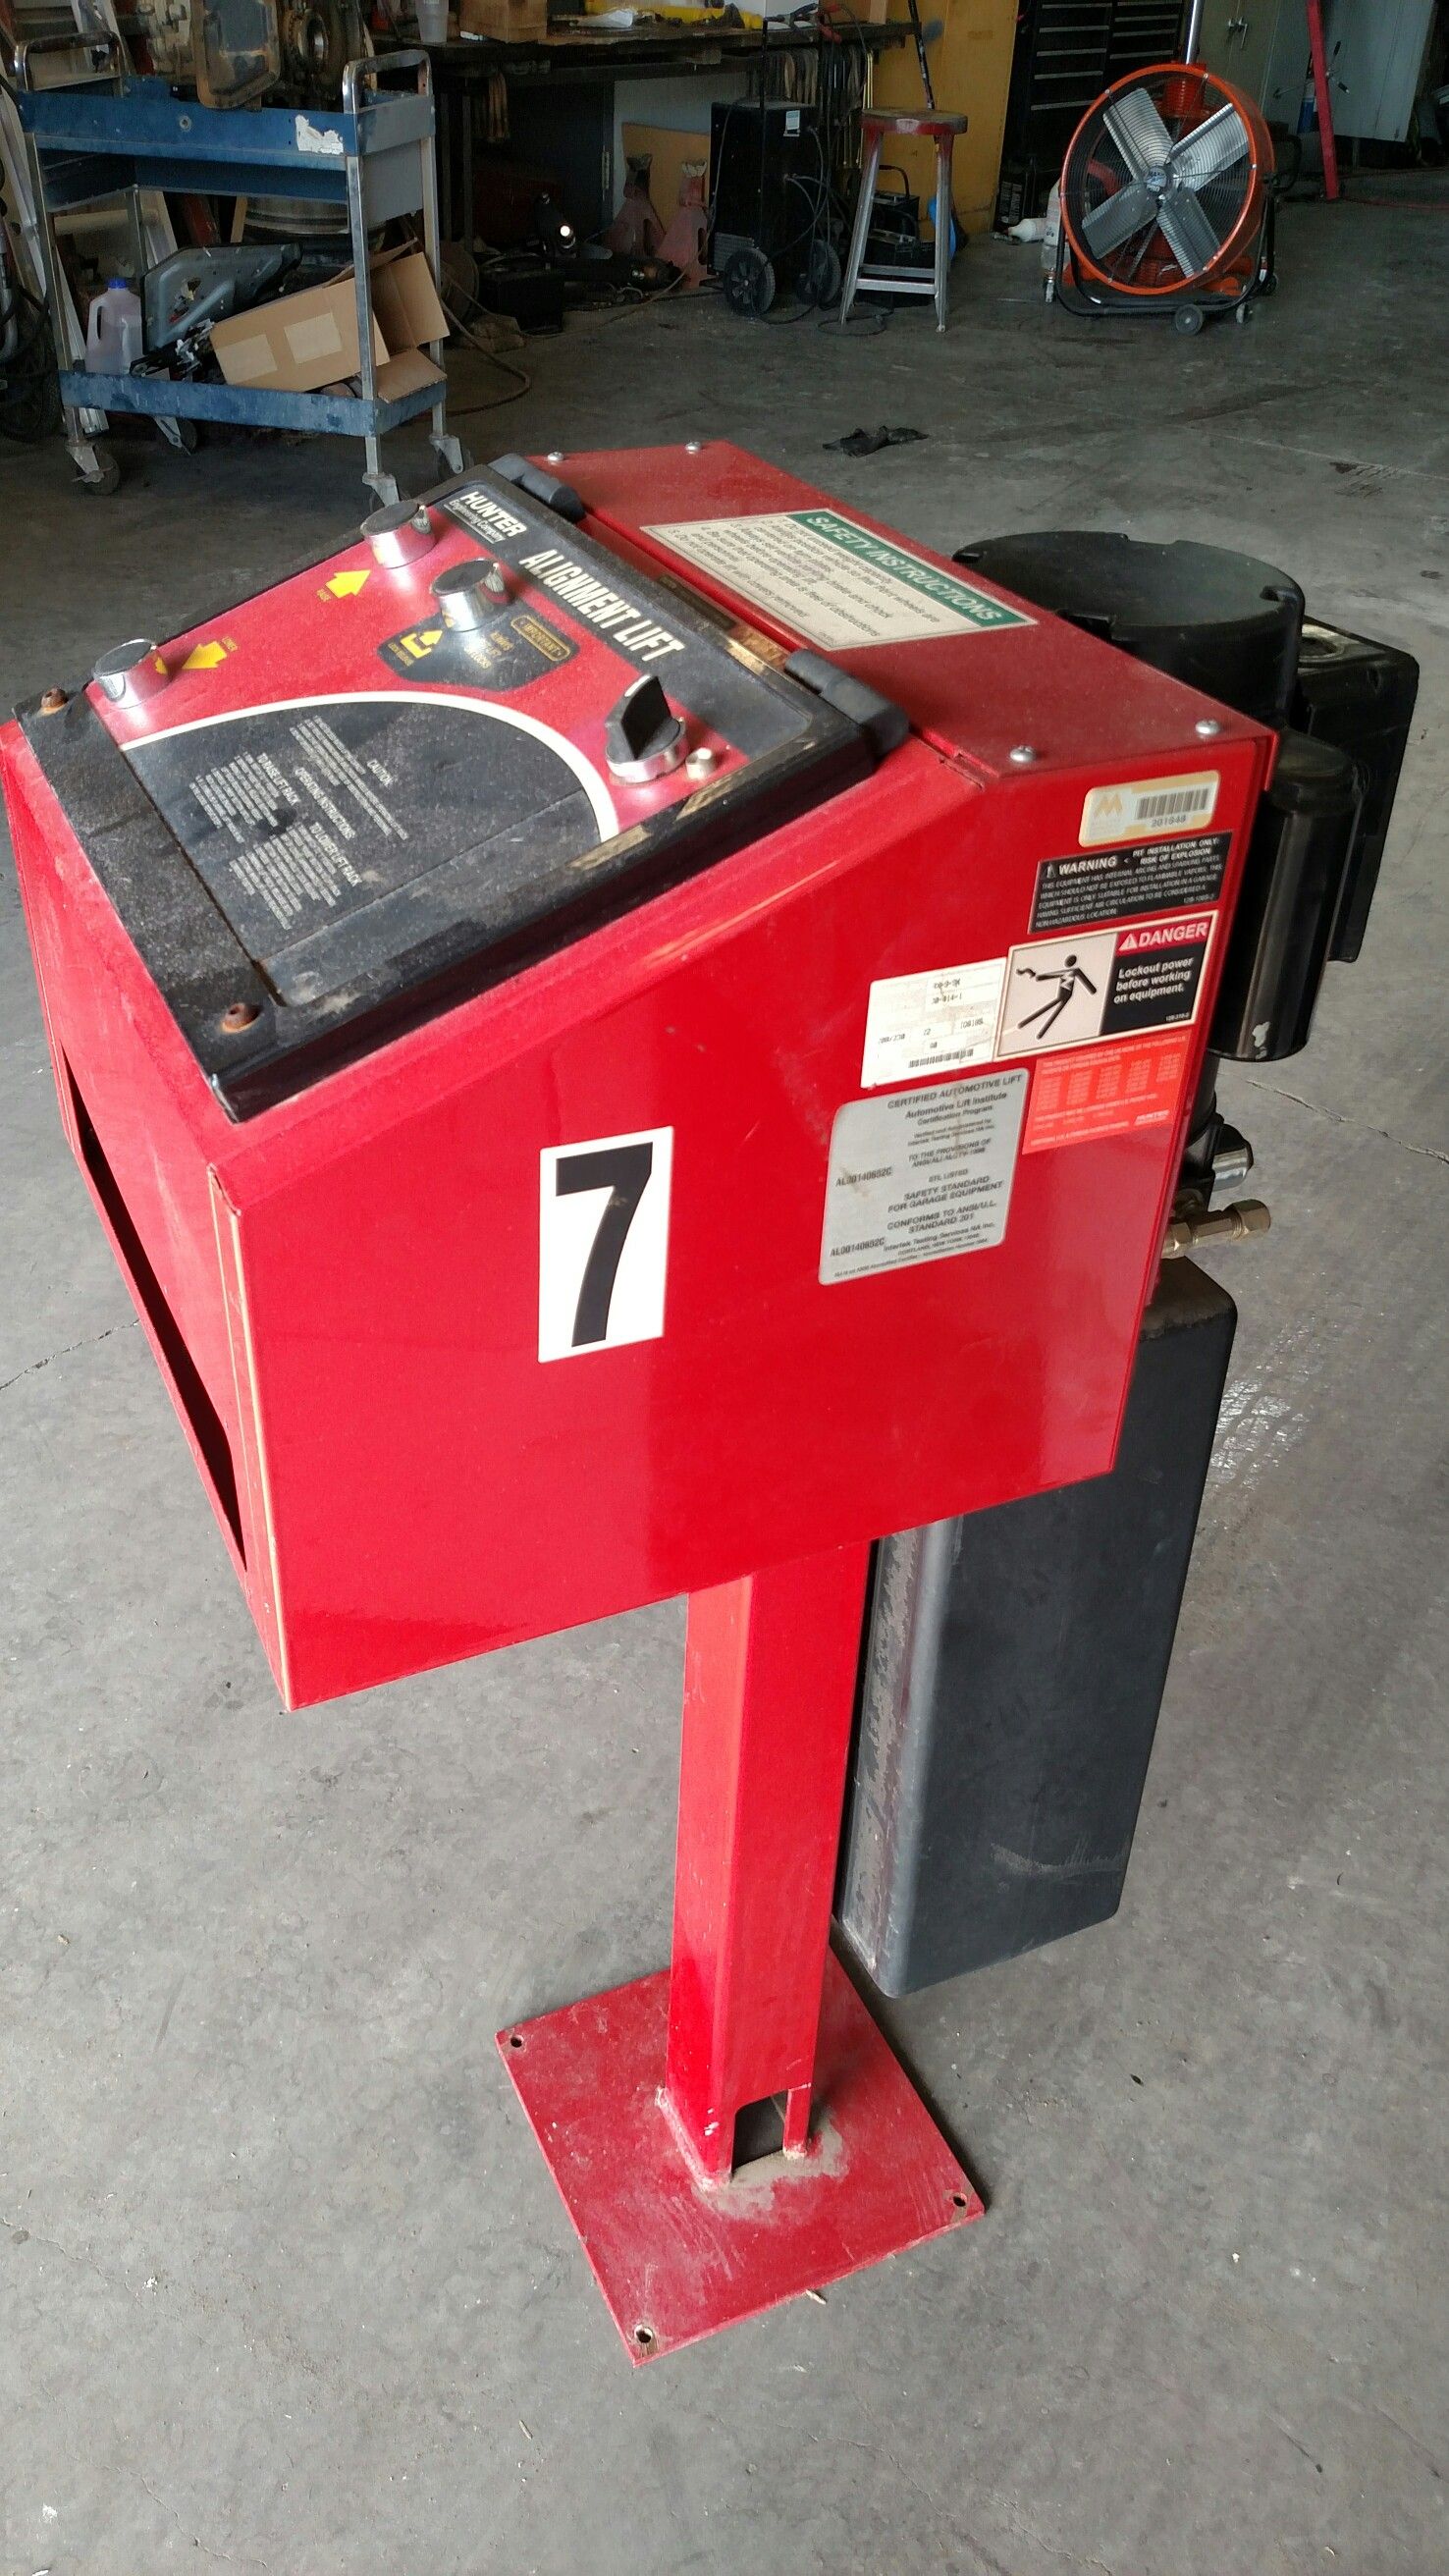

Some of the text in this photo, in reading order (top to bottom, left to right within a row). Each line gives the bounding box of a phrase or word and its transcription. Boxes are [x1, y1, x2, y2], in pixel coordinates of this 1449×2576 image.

[459, 491, 527, 537] HUNTER
[807, 517, 874, 550] SAFETY
[866, 550, 1002, 619] INSTRUCTIONS
[518, 550, 685, 662] ALIGNMENT LIFT
[1133, 848, 1145, 857] PIT
[1147, 841, 1197, 854] INSTALLATION
[1140, 856, 1156, 865] RISK
[1170, 848, 1211, 860] EXPLOSION
[1059, 856, 1117, 875] WARNING
[1139, 922, 1208, 948] DANGER
[1118, 958, 1194, 979] Lockout power
[1115, 970, 1191, 992] before working
[1113, 983, 1184, 1004] on equipment.
[887, 1074, 1022, 1109] CERTIFIED AUTOMOTIVE LIFT
[905, 1092, 1007, 1119] Automotive Lift Institute
[917, 1105, 993, 1126] Certification Program
[936, 1141, 980, 1154] PROVISIONS
[943, 1168, 969, 1179] LISTED
[887, 1181, 1003, 1212] FOR GARAGE EQUIPMENT
[904, 1175, 990, 1201] SAFETY STANDARD
[887, 1211, 940, 1230] CONFORMS
[942, 1208, 954, 1217] TO
[909, 1213, 974, 1233] STANDARD 201
[556, 1141, 654, 1347] 7
[913, 1235, 938, 1245] Testing
[939, 1228, 969, 1239] Services
